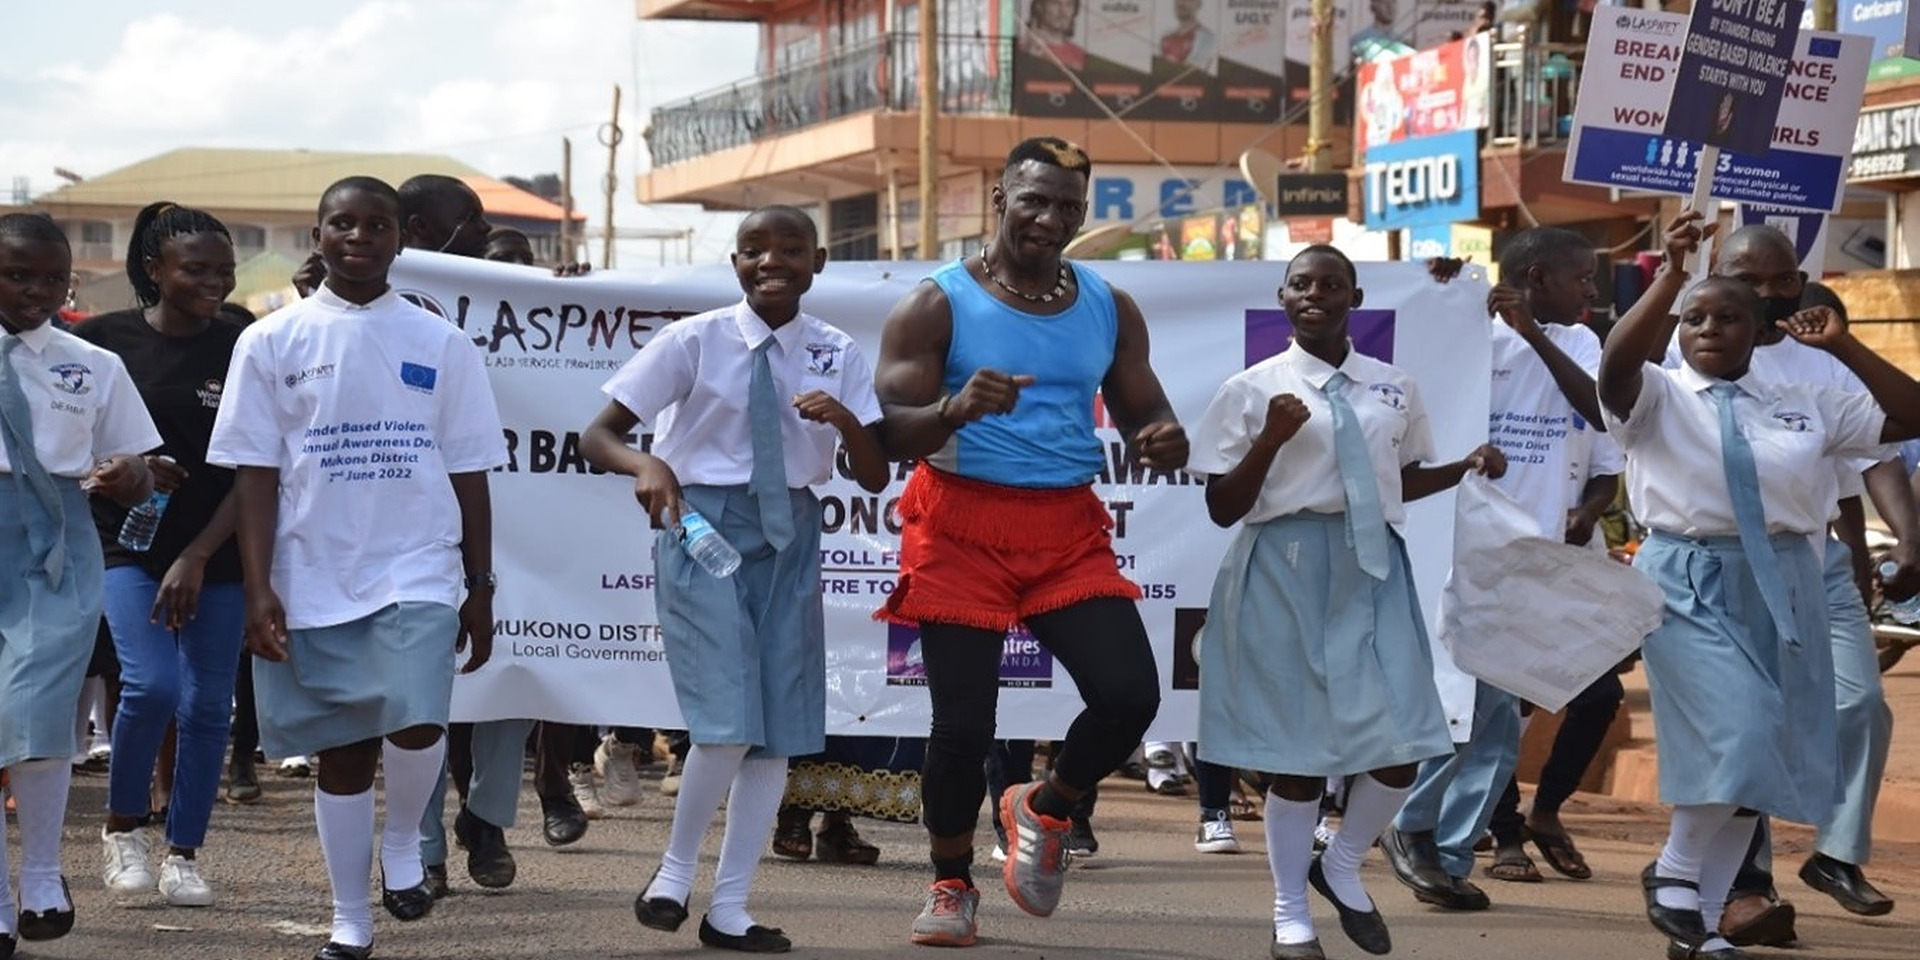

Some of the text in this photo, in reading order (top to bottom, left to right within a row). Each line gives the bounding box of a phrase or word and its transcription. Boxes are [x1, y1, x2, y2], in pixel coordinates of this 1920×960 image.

[1755, 0, 1777, 25] BE
[1774, 2, 1787, 29] A
[1710, 16, 1721, 32] BY
[1750, 28, 1777, 48] ENDING
[1686, 32, 1788, 79] GENDER BASED VIOLENCE
[1620, 62, 1830, 102] END NCE
[1699, 65, 1768, 97] STARTS WITH YOU
[1717, 153, 1733, 173] 3
[1732, 164, 1781, 179] women
[1367, 154, 1457, 215] TECNO
[1611, 171, 1640, 183] sexual
[1641, 175, 1680, 187] violence
[1620, 163, 1669, 177] worldwide
[1669, 168, 1693, 180] have
[1750, 178, 1790, 192] physical
[1720, 183, 1732, 194] by
[1733, 186, 1771, 198] intimate
[1772, 191, 1808, 202] partner
[341, 420, 380, 433] Based
[1505, 411, 1538, 424] Based
[1546, 428, 1568, 439] Day
[341, 438, 411, 450] Awareness
[370, 453, 419, 464] District
[345, 470, 376, 482] June
[379, 468, 412, 479] 2022
[820, 550, 875, 566] TOLL
[492, 619, 591, 640] MUKONO
[512, 641, 560, 659] Local
